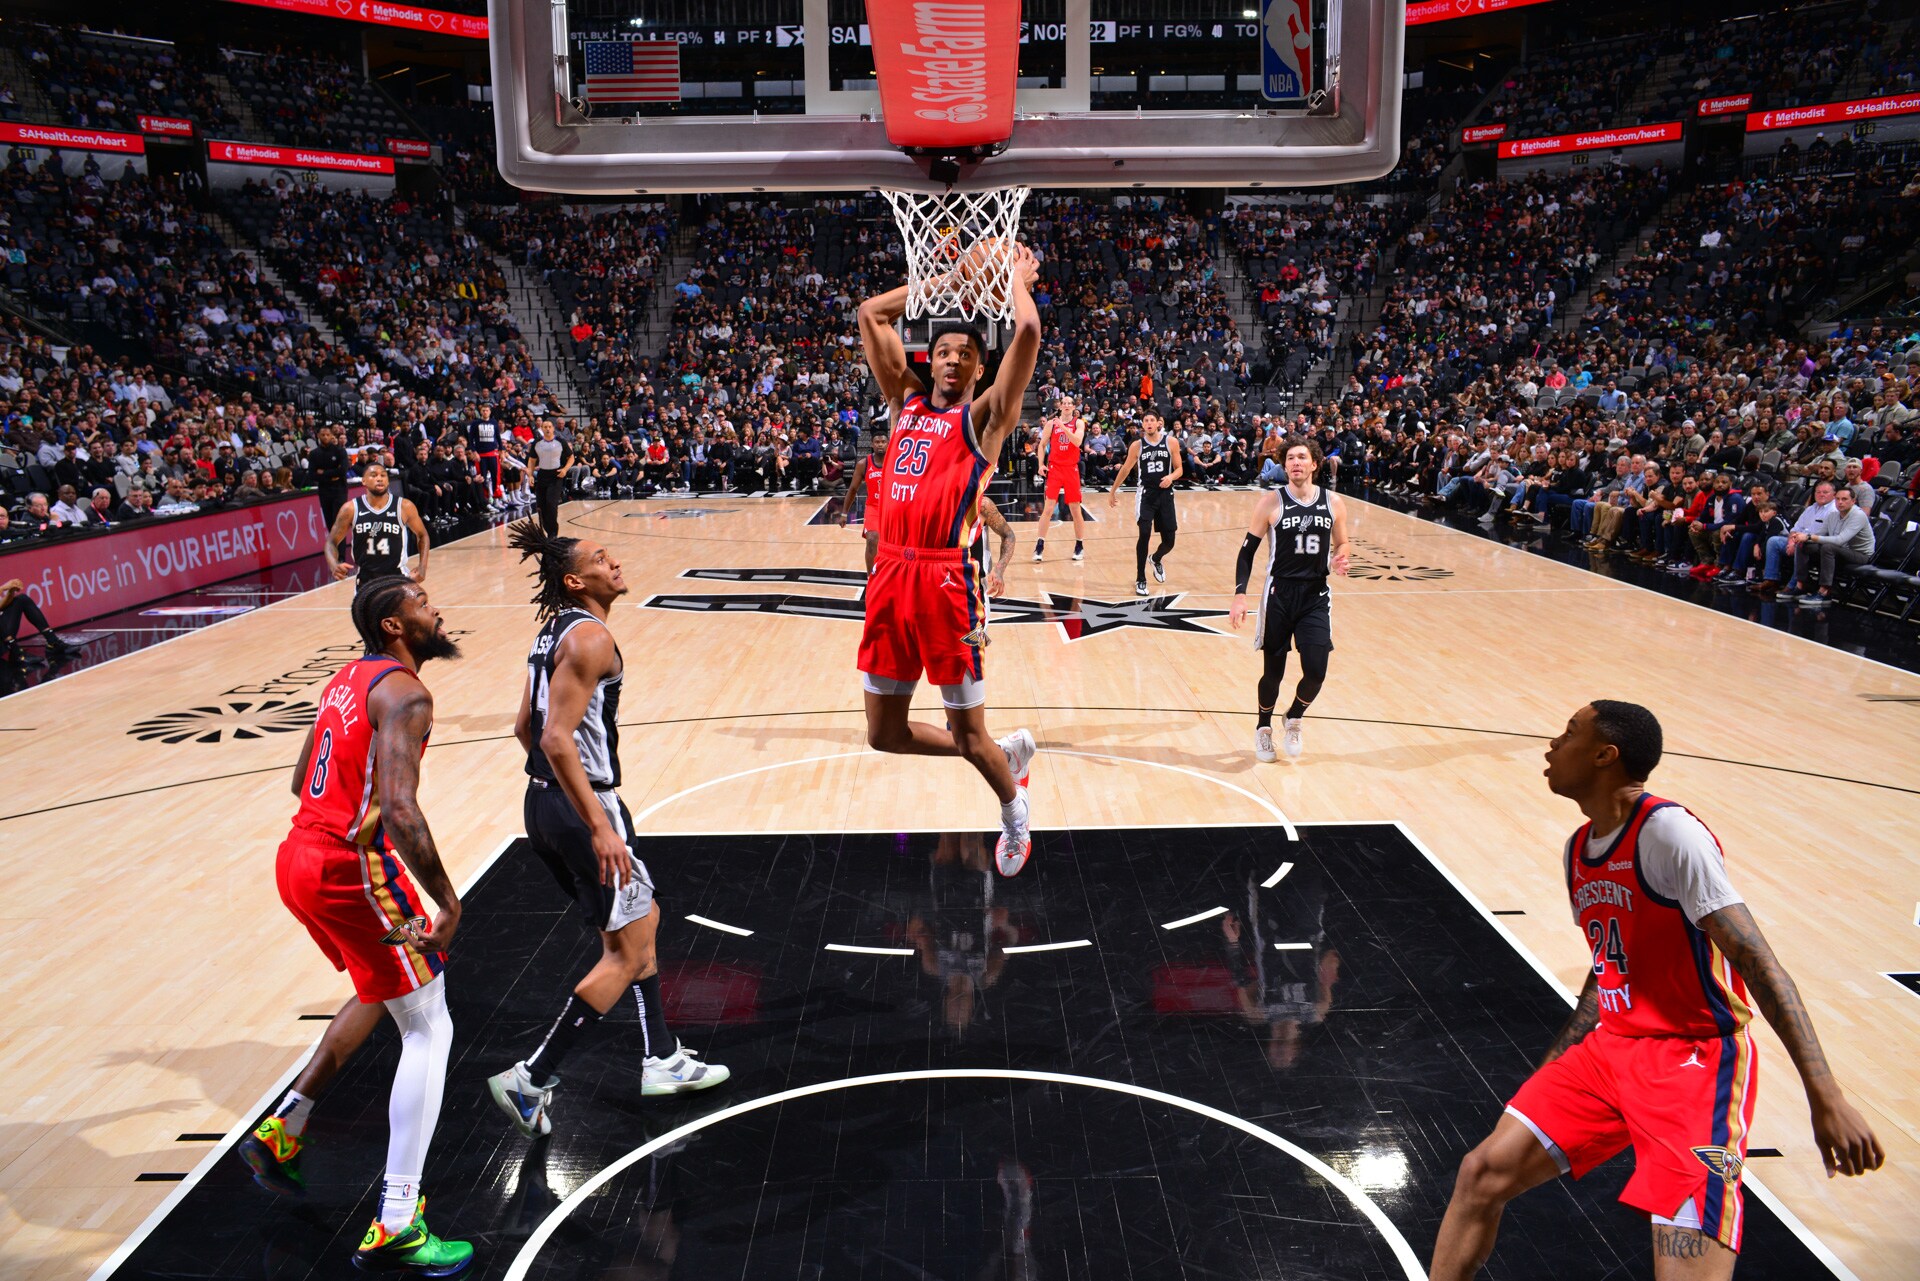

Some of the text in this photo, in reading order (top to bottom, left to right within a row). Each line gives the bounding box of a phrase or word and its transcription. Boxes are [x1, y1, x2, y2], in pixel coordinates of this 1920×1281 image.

[373, 5, 423, 22] Methodist
[714, 31, 725, 44] 54
[738, 31, 760, 43] PF
[765, 31, 772, 43] 2
[1119, 25, 1141, 38] PF
[1164, 24, 1203, 38] FG%
[1211, 25, 1223, 38] 40
[1234, 24, 1258, 37] TO
[1269, 74, 1293, 93] NBA
[1711, 98, 1749, 108] Methodist
[1776, 109, 1825, 121] Methodist
[151, 119, 190, 131] Methodist
[1472, 127, 1504, 137] Methodist
[18, 128, 127, 148] SAHealth.com/heart
[1576, 128, 1665, 146] SAHealth.com/heart
[396, 142, 428, 151] Methodist
[1521, 139, 1560, 151] Methodist
[237, 147, 280, 159] Methodist
[296, 153, 381, 168] SAHealth.com/heart
[303, 172, 319, 182] 112
[893, 437, 932, 477] 25
[1147, 460, 1164, 473] 23
[891, 481, 918, 502] CITY
[366, 538, 390, 555] 14
[1294, 534, 1320, 554] 16
[25, 521, 271, 608] of love in YOUR HEART.
[310, 728, 332, 798] 8
[1607, 860, 1633, 872] ibotta
[1588, 917, 1628, 975] 24
